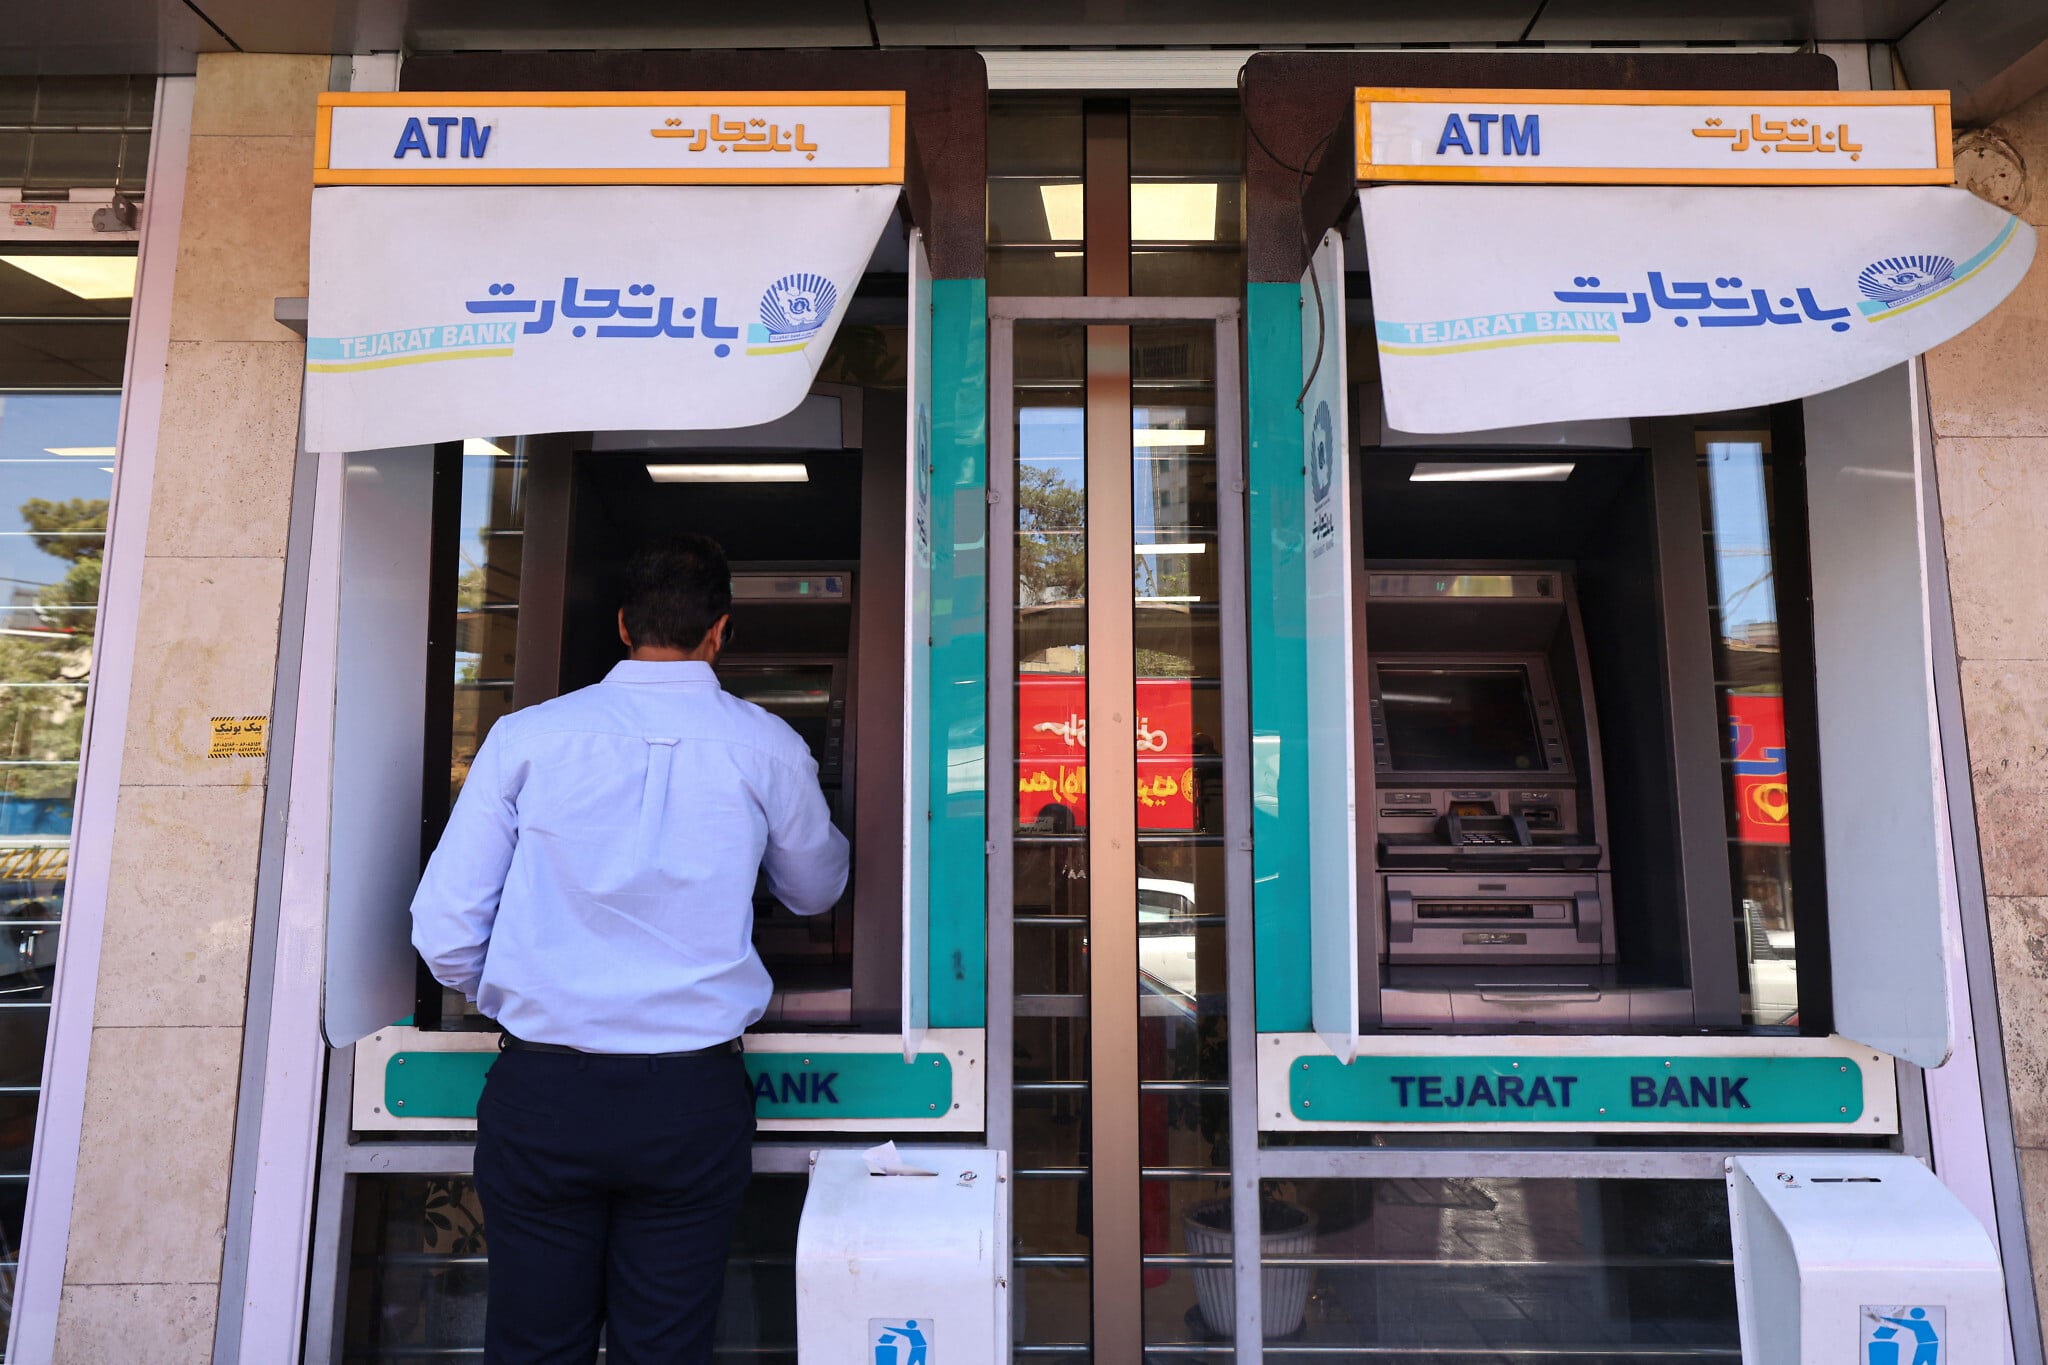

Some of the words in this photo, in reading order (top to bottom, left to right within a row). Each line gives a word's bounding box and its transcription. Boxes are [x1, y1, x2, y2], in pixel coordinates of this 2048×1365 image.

[393, 116, 492, 159] ATM
[1436, 113, 1540, 156] ATM
[340, 328, 435, 358] TEJARAT
[442, 323, 514, 347] BANK
[1404, 313, 1527, 343] TEJARAT
[1534, 311, 1615, 331] BANK
[755, 1072, 839, 1104] ANK
[1390, 1074, 1579, 1108] TEJARAT
[1630, 1075, 1751, 1109] BANK
